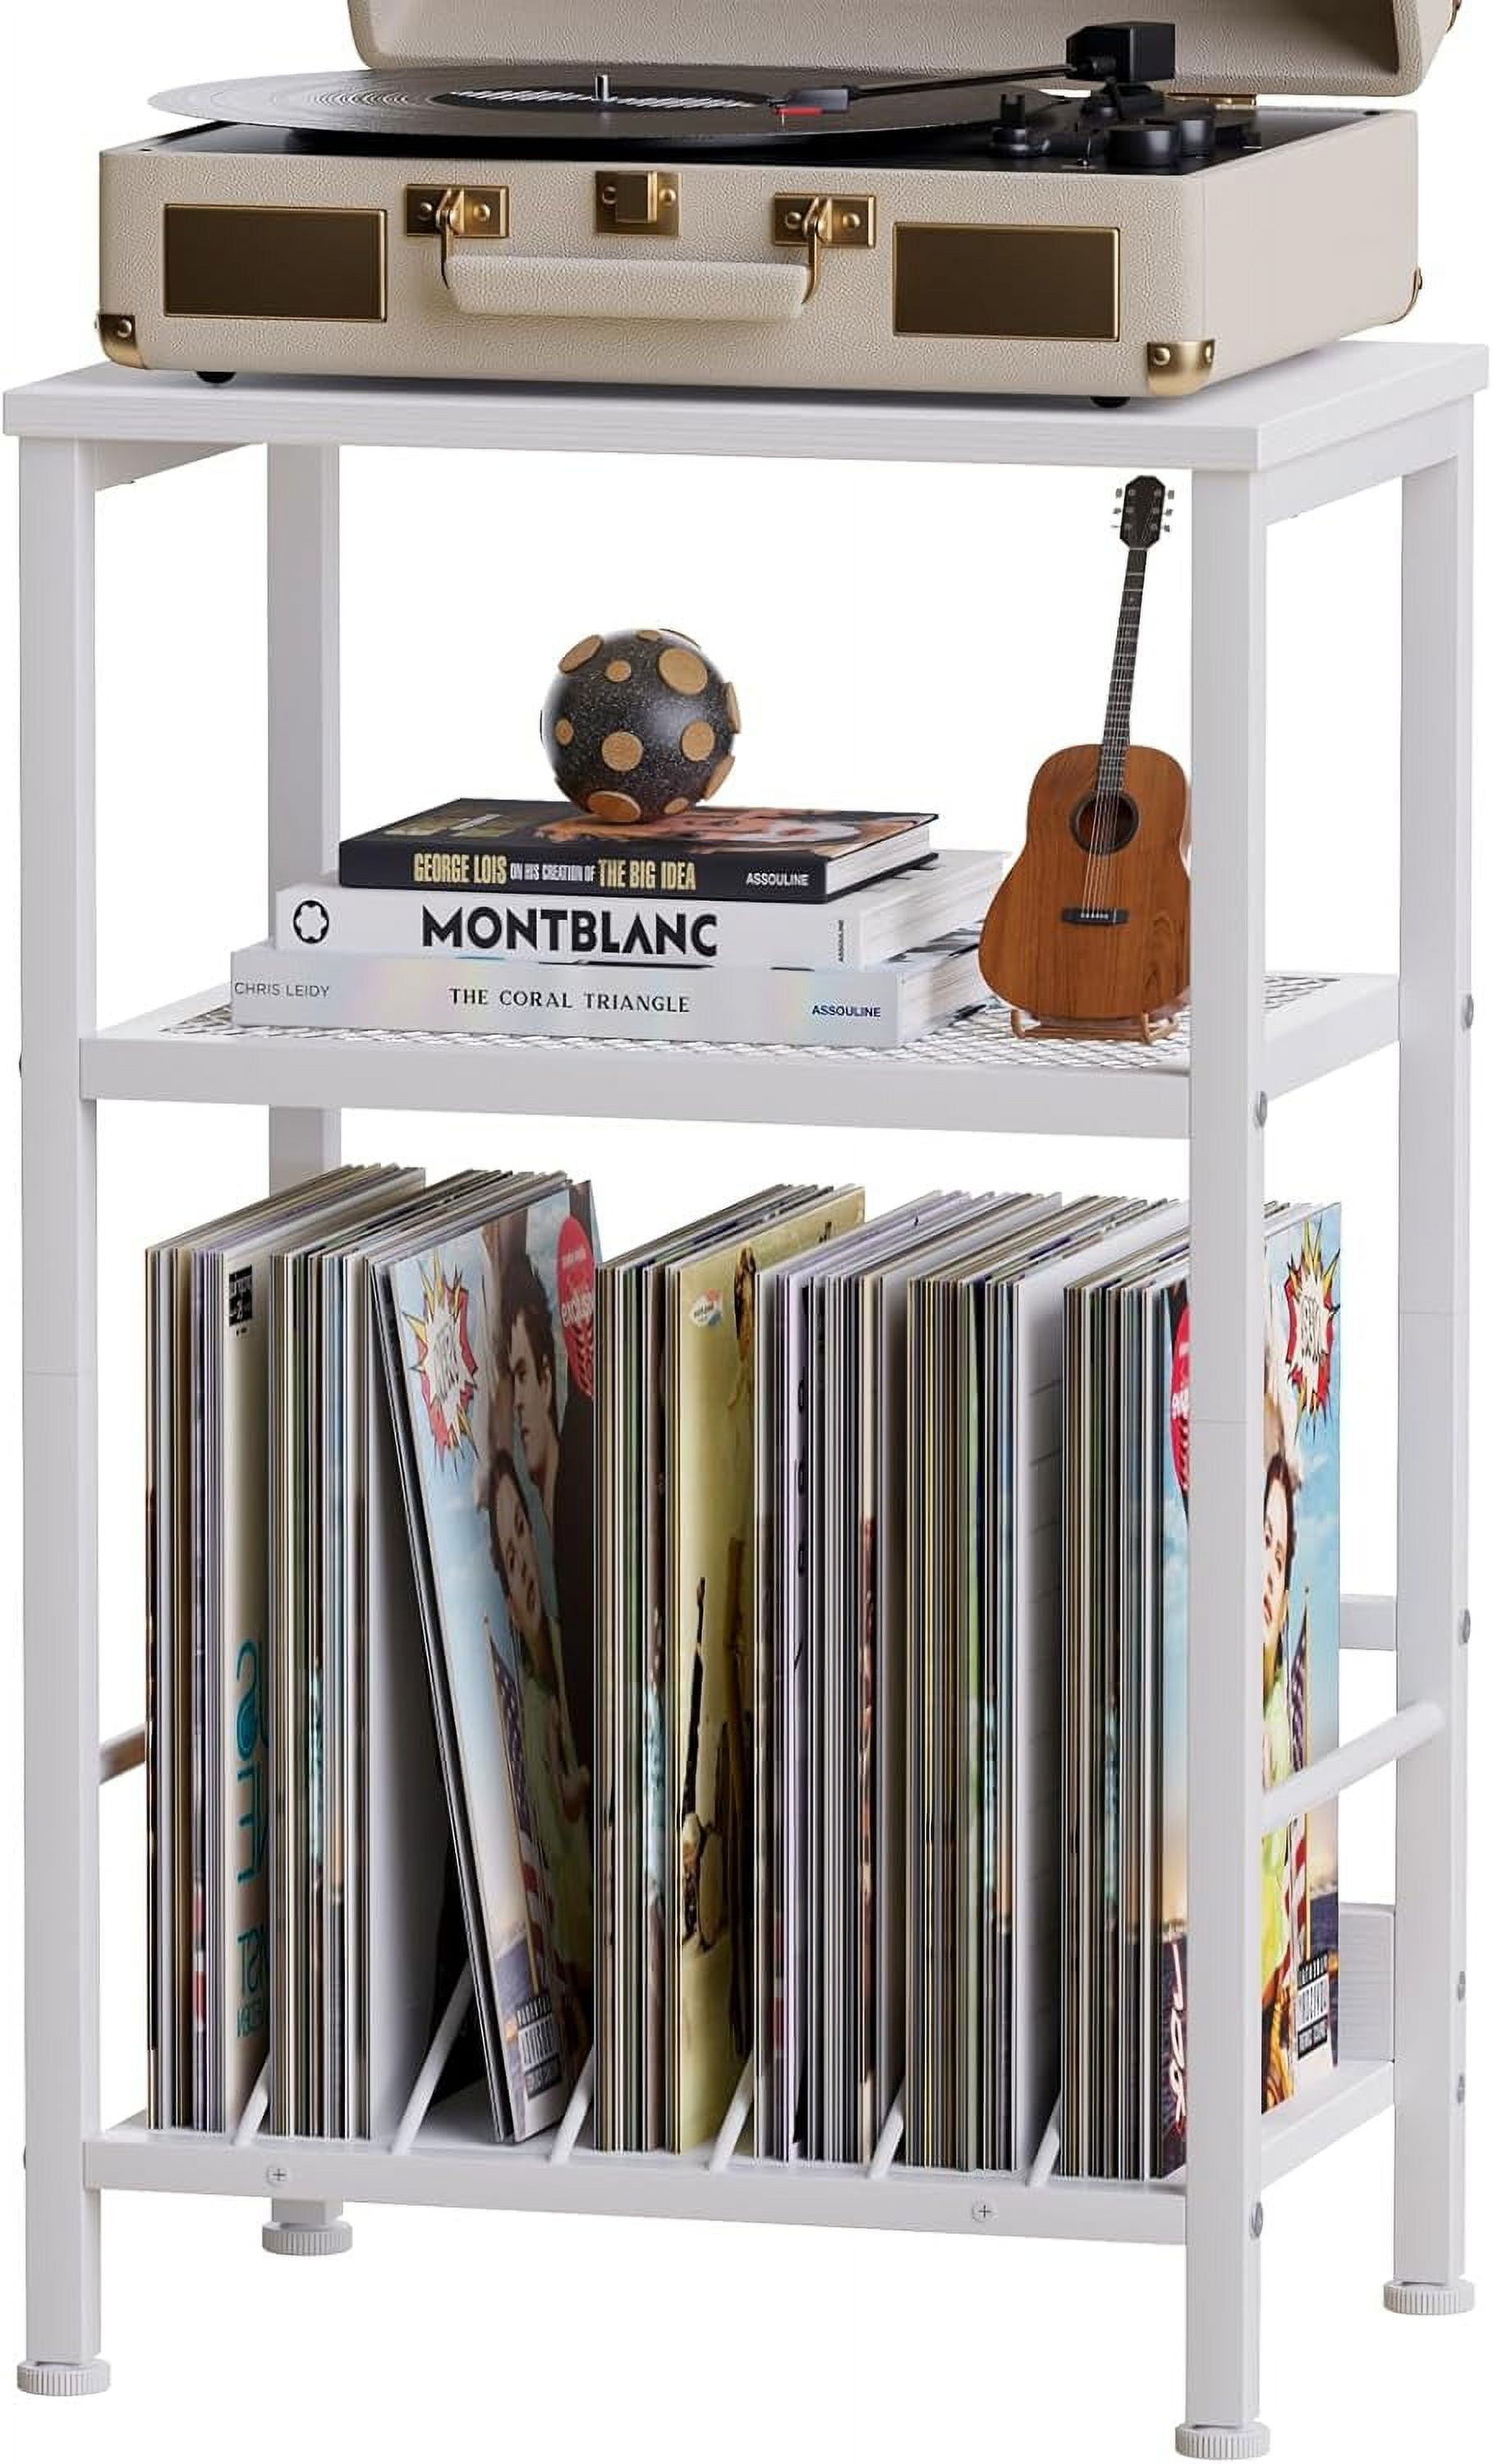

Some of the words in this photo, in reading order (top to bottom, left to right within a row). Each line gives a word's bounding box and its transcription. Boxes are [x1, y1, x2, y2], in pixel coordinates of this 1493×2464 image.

[414, 853, 470, 883] GEORGE
[474, 854, 507, 885] LOIS
[510, 862, 523, 880] ON
[524, 863, 540, 881] HIS
[542, 864, 583, 881] CREATION
[584, 865, 596, 881] OF
[598, 858, 627, 888] THE
[629, 860, 656, 890] BIG
[660, 861, 696, 890] IDEA
[745, 871, 810, 887] ASSOULINE
[422, 905, 718, 958] MONTBLANC
[234, 981, 280, 996] CHRIS
[285, 984, 330, 998] LEIDY
[449, 988, 489, 1005] THE
[498, 990, 573, 1009] CORAL
[584, 992, 691, 1013] TRIANGLE
[811, 1004, 881, 1018] ASSOULINE
